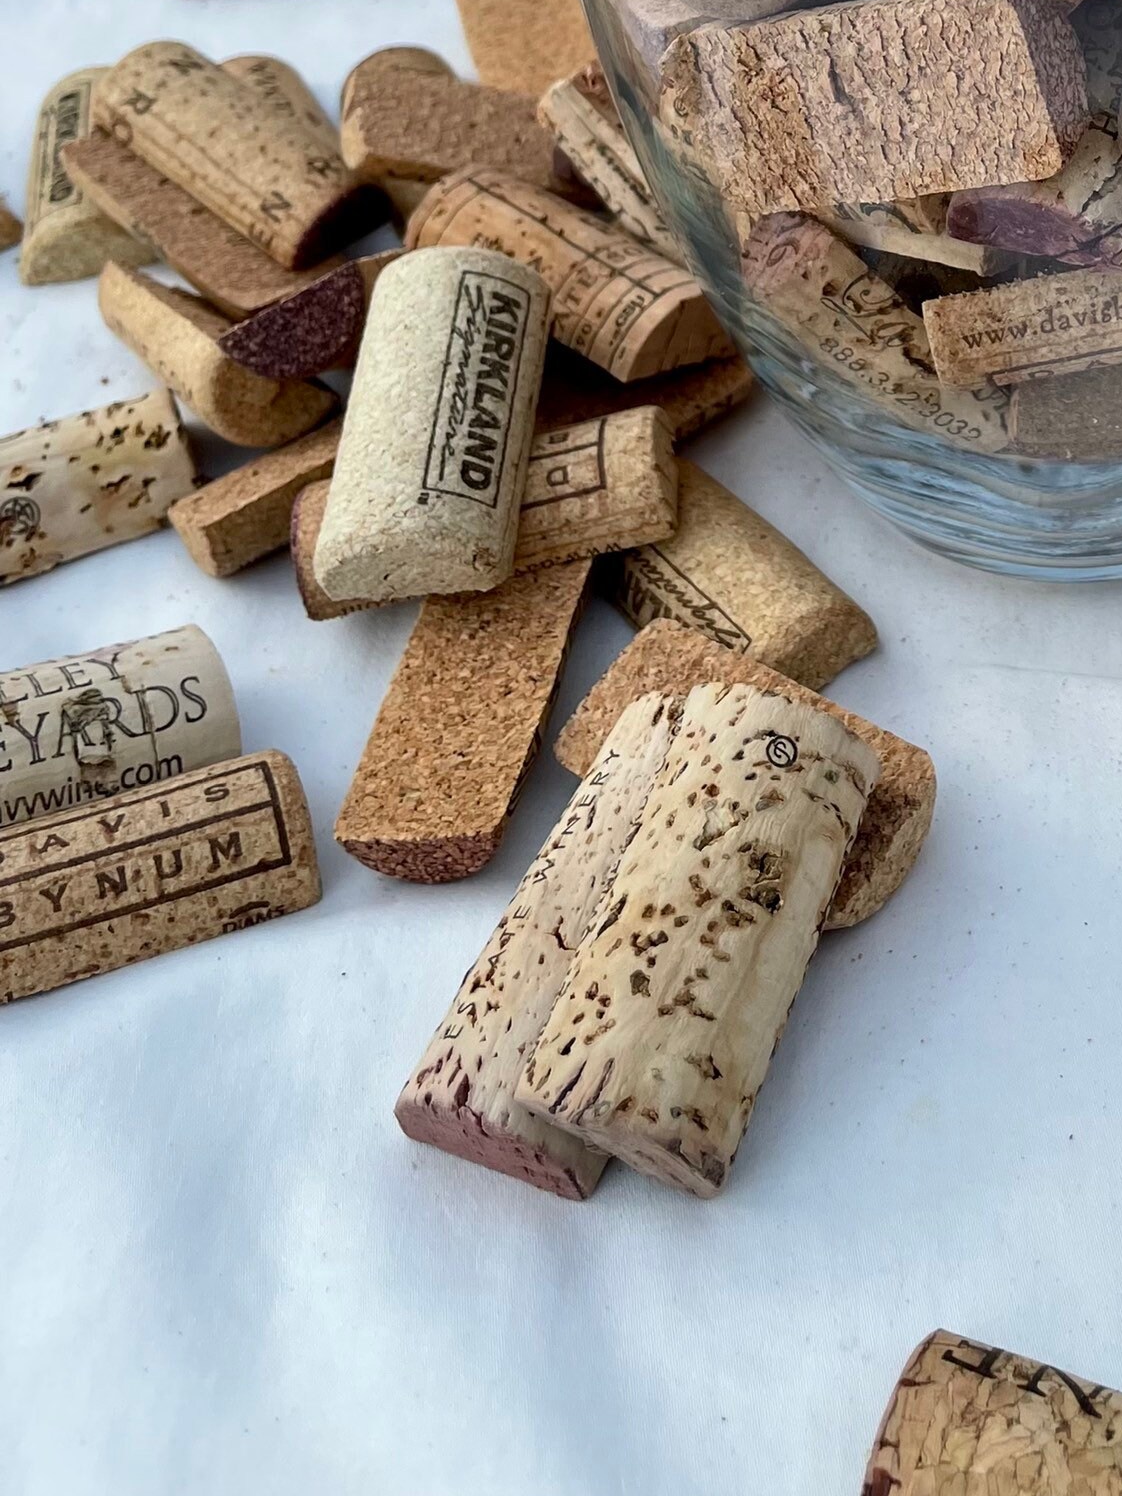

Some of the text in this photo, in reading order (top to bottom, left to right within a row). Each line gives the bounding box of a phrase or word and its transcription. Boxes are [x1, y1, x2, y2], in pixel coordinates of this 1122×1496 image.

[438, 284, 487, 482] Signature
[460, 290, 521, 492] KIRKLAND
[0, 782, 231, 864] AVIS
[531, 748, 621, 885] WINERY
